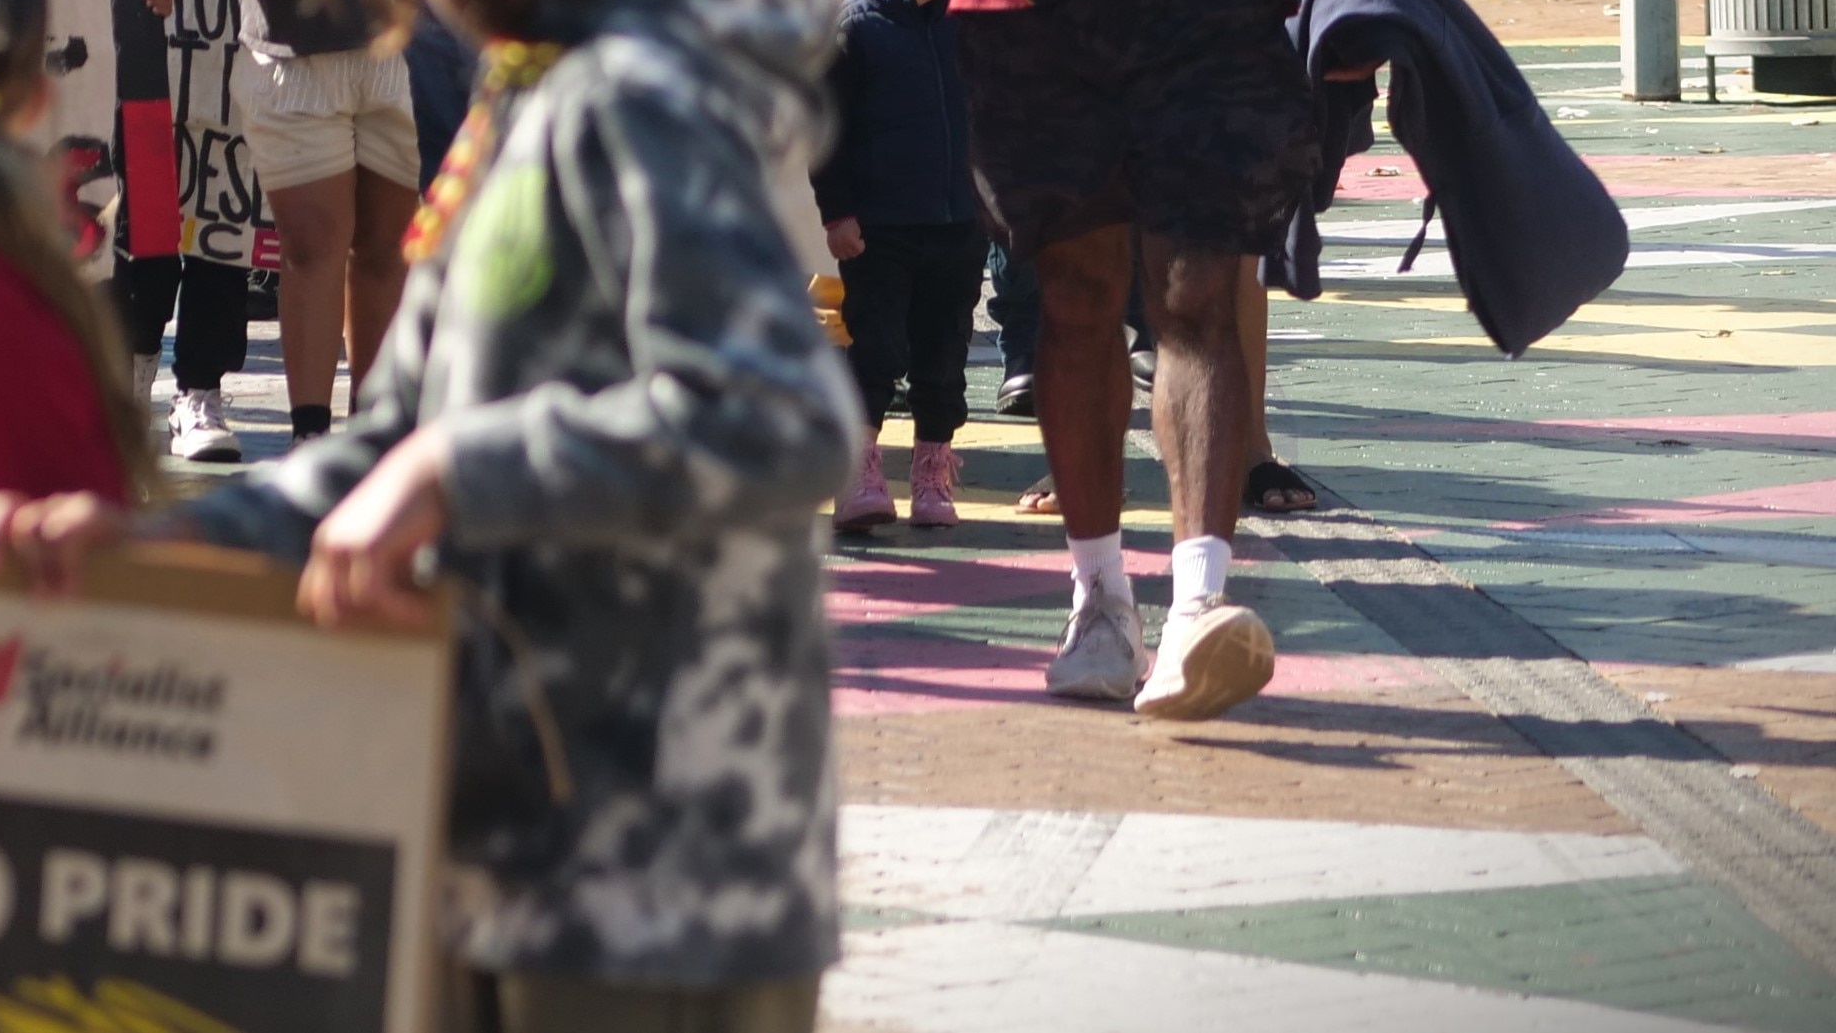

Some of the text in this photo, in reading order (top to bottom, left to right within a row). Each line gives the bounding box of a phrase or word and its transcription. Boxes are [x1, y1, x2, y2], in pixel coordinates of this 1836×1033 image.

[21, 646, 228, 712] Socialist
[18, 694, 216, 763] Alliance
[37, 847, 361, 978] PRIDE
